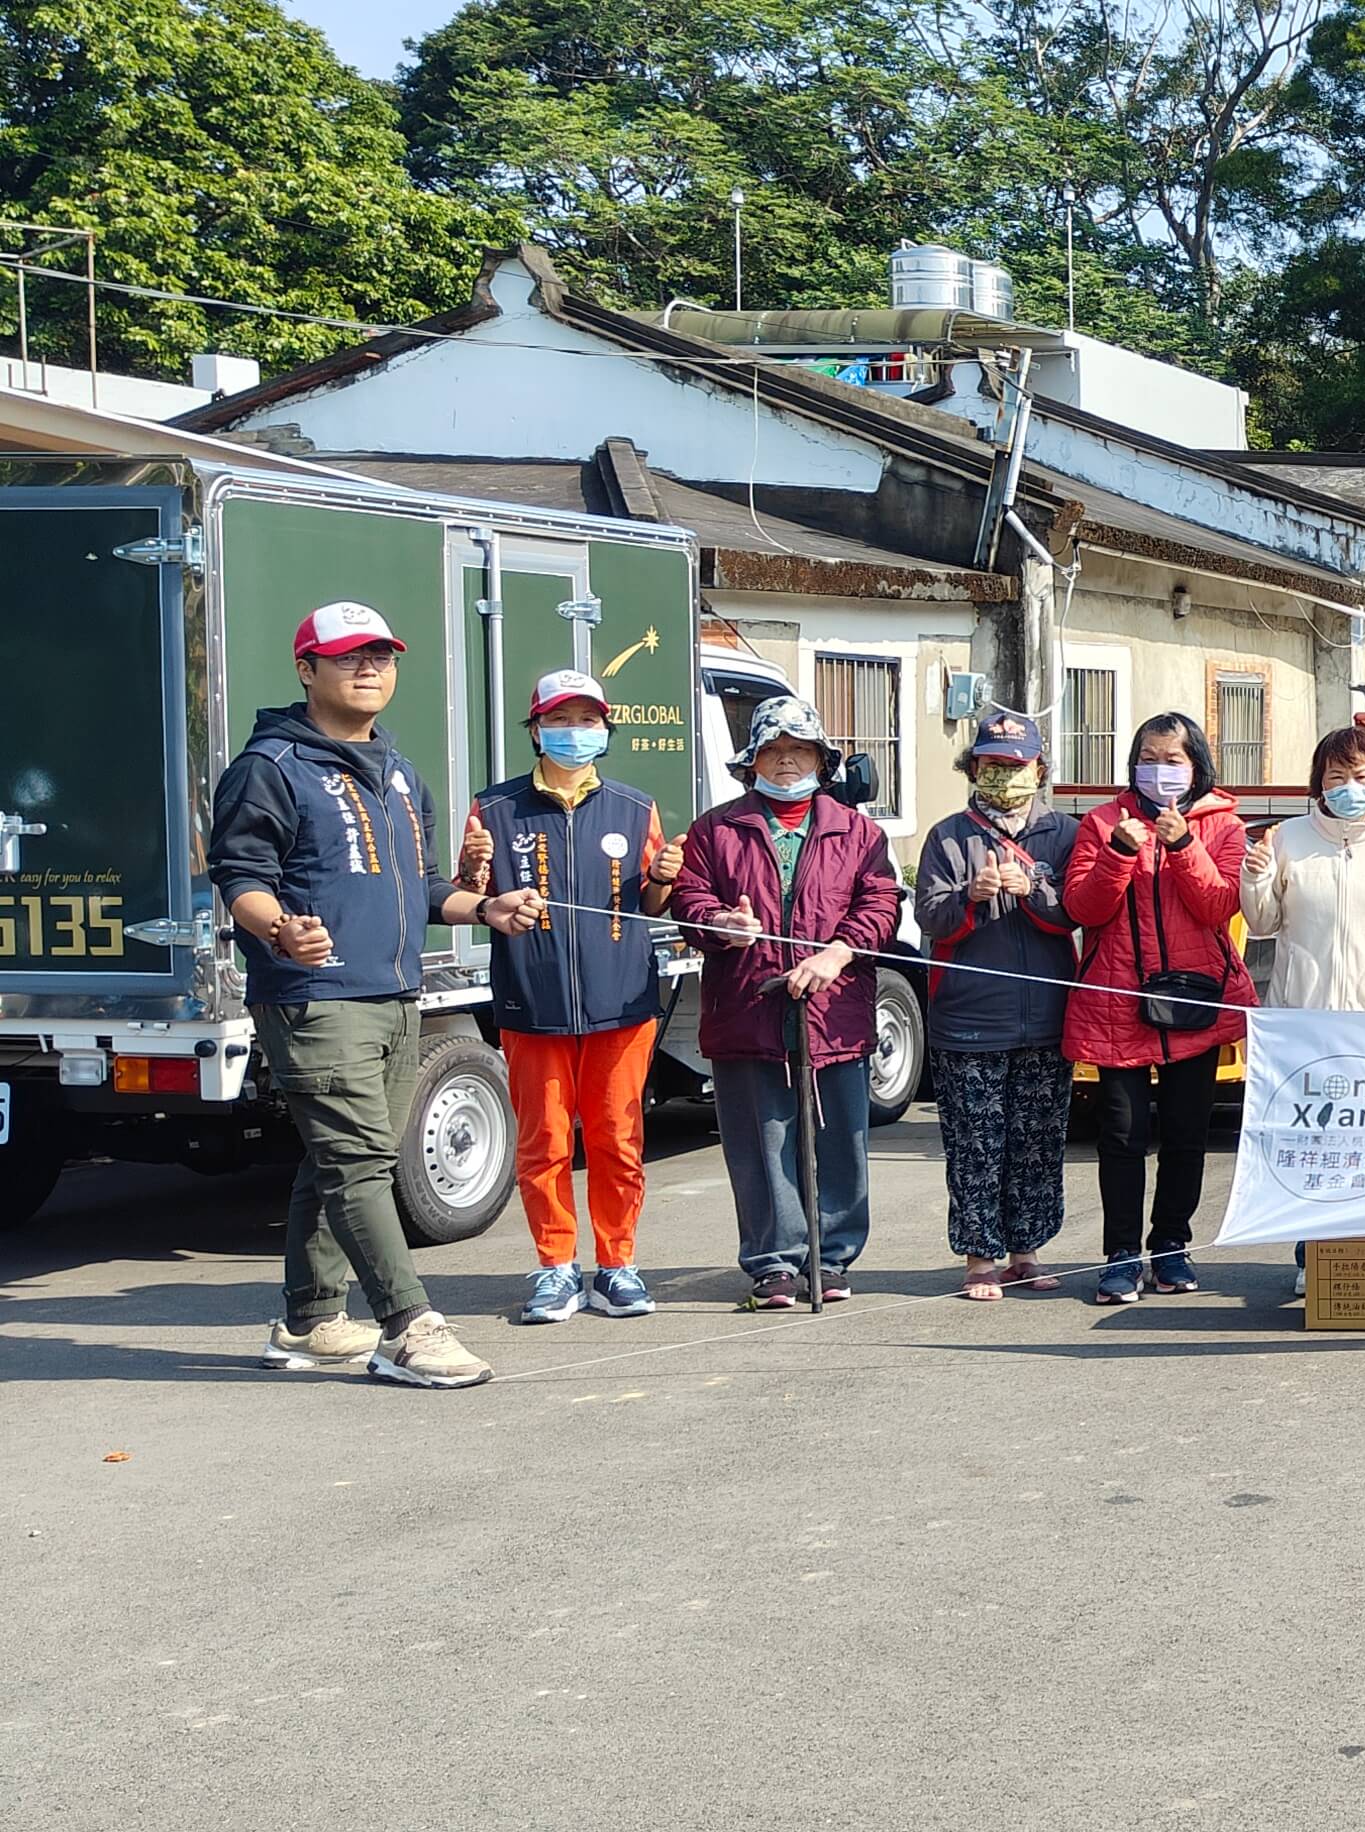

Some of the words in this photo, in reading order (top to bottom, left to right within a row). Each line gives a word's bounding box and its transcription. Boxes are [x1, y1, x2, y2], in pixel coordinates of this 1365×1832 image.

[20, 873, 42, 890] easy
[43, 868, 61, 886] for
[59, 876, 81, 890] you
[83, 870, 94, 883] to
[96, 867, 122, 885] relax
